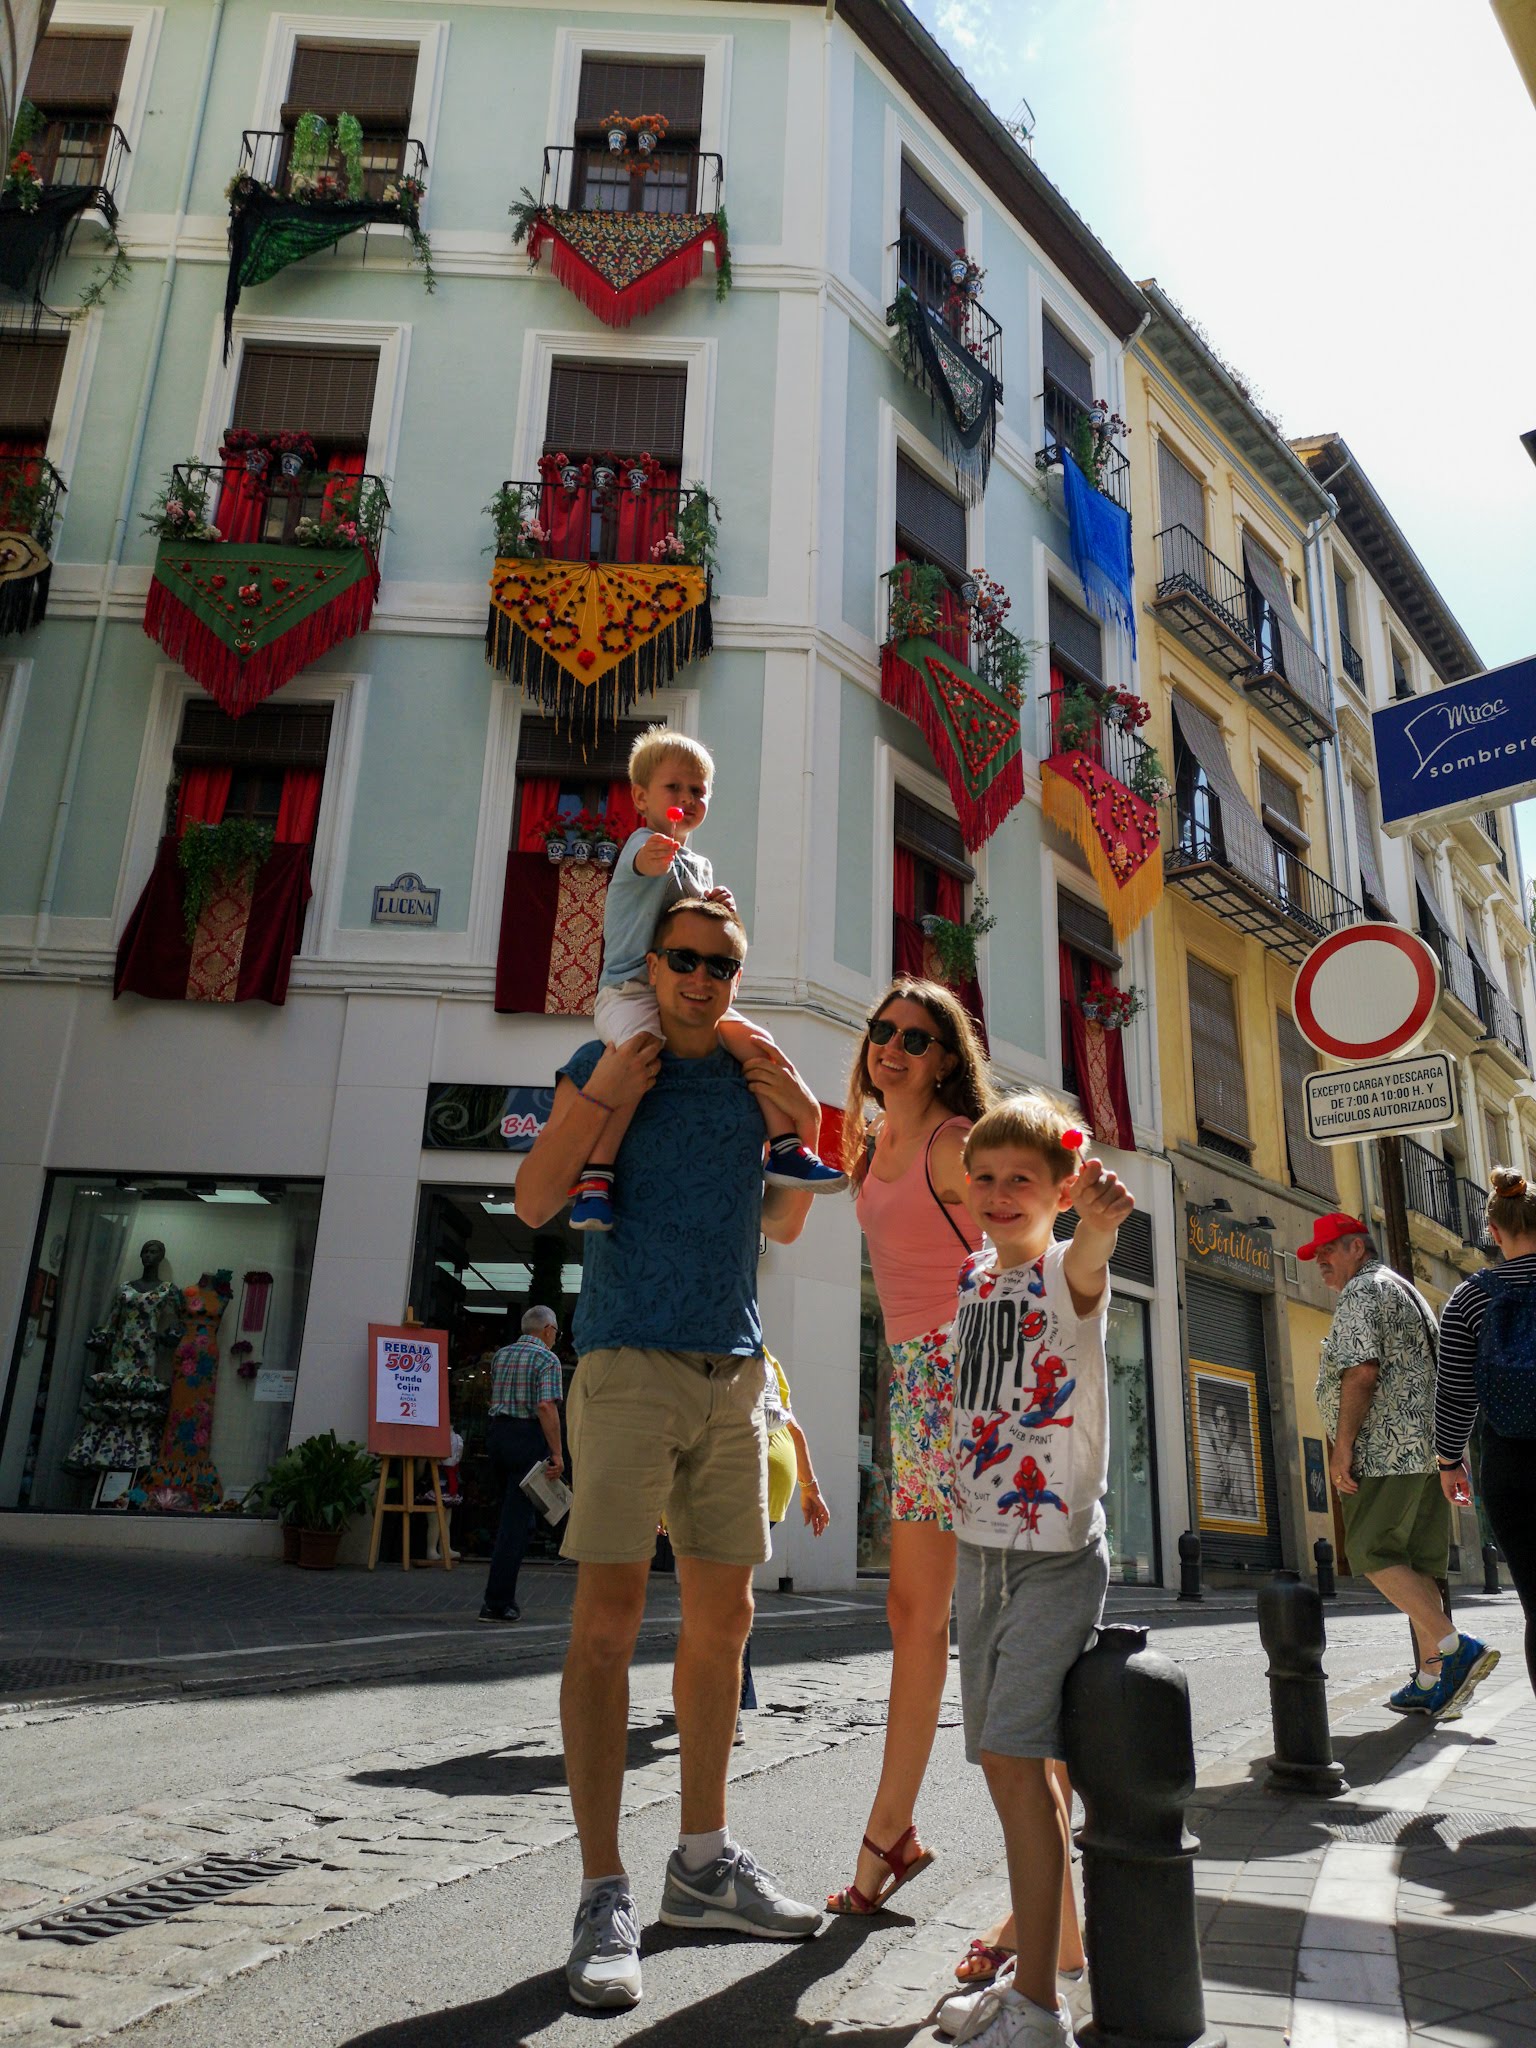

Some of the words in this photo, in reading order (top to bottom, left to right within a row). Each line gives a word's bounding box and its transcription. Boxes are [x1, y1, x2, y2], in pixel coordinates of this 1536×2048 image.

[378, 898, 432, 916] LUCENA
[1312, 1082, 1351, 1098] EXCEPTO
[1353, 1077, 1384, 1092] CARGA
[1385, 1075, 1391, 1086] Y
[1392, 1066, 1444, 1085] DESCARGA
[1331, 1098, 1345, 1110] DE
[1346, 1094, 1369, 1107] 7:00
[1371, 1092, 1379, 1103] A
[1380, 1087, 1410, 1101] 10:00
[1426, 1083, 1434, 1094] Y
[1373, 1096, 1447, 1118] AUTORIZADOS
[1189, 1215, 1209, 1255] La
[384, 1342, 432, 1356] REBAJA
[385, 1353, 432, 1373] 50%
[394, 1373, 422, 1383] Funda
[1009, 1424, 1026, 1441] WEB
[1029, 1433, 1054, 1445] PRINT
